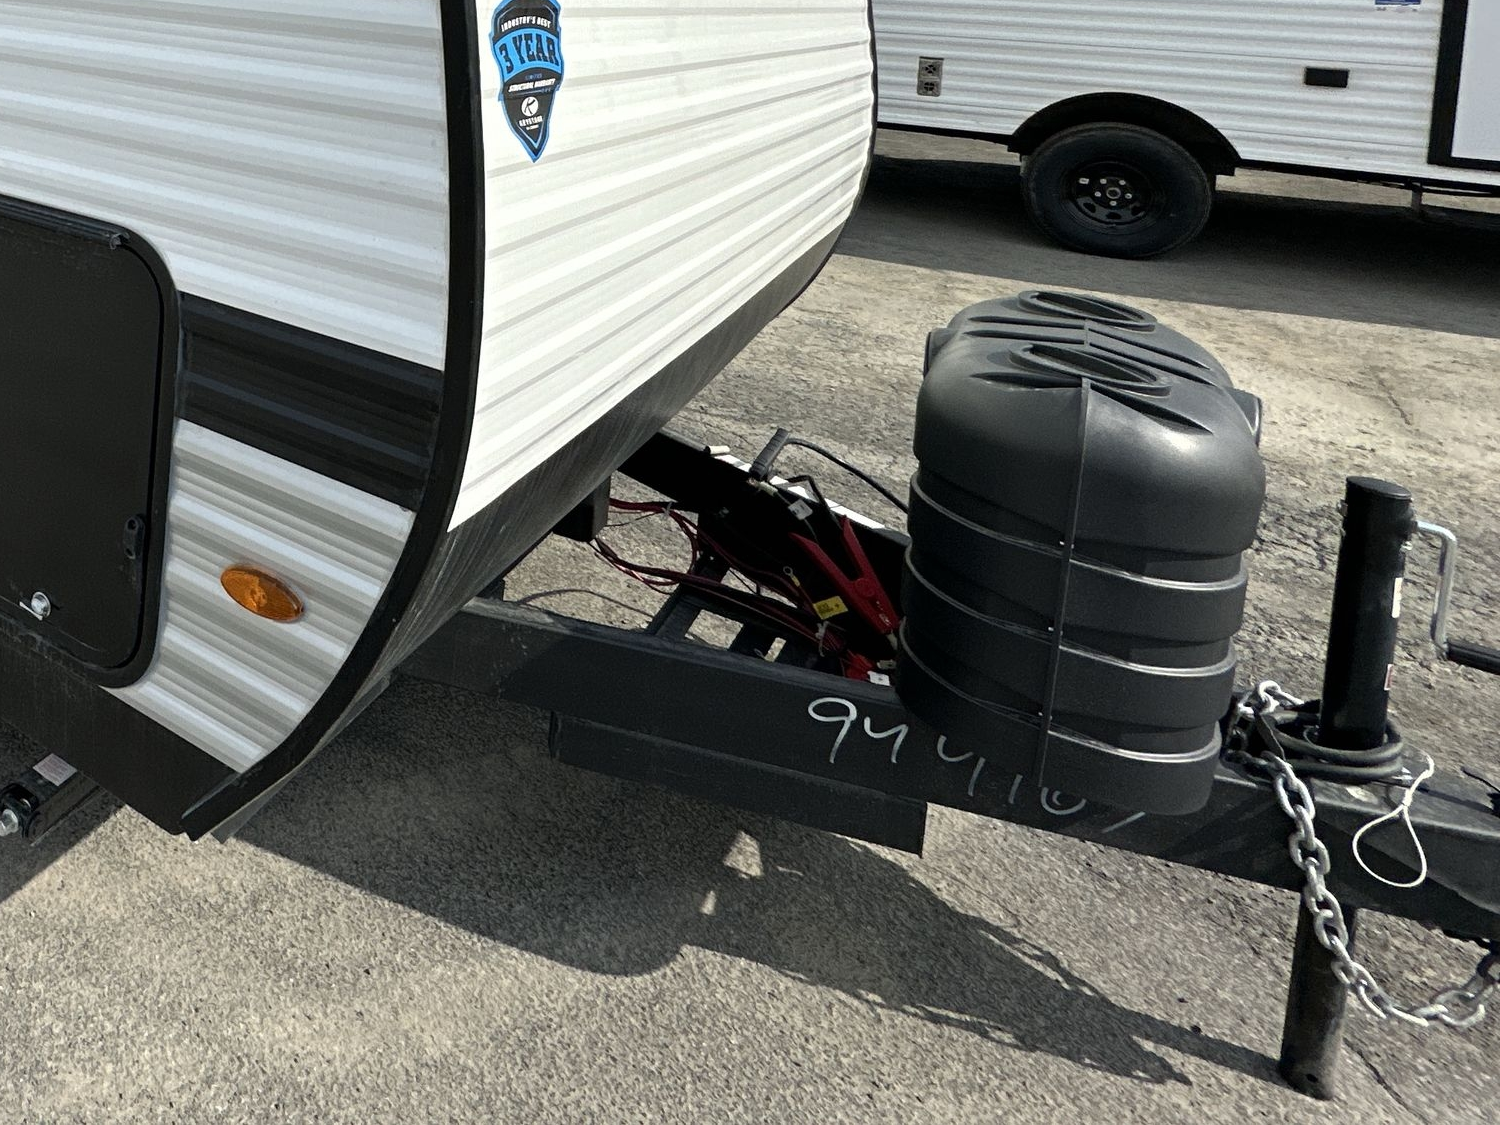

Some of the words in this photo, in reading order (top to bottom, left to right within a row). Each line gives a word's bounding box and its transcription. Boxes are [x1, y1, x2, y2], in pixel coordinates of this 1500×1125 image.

[537, 17, 551, 28] BEST
[499, 43, 514, 74] 3
[512, 33, 559, 66] YEAR
